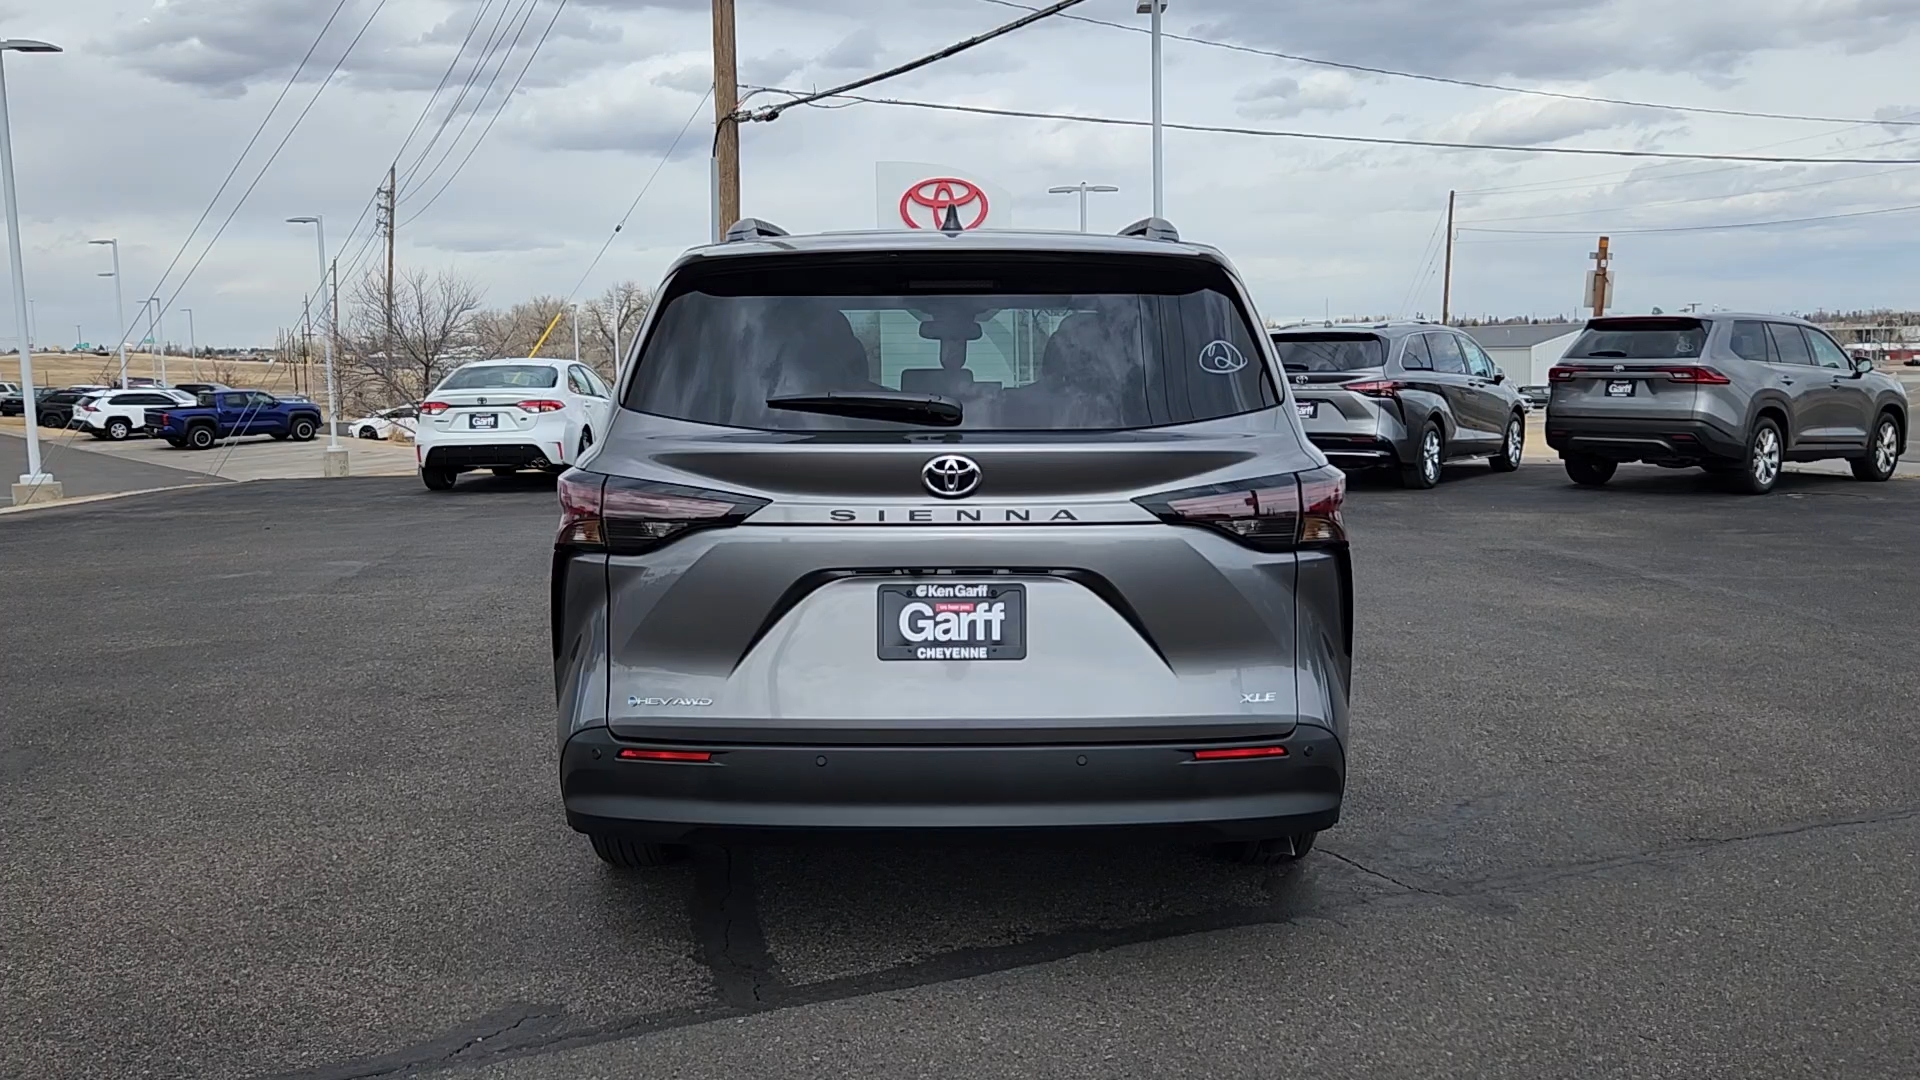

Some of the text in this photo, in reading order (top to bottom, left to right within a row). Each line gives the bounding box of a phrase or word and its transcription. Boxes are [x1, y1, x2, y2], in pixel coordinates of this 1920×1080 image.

[830, 509, 1078, 522] SIENNA
[928, 585, 988, 597] Ken Garff
[899, 602, 1005, 642] Garff
[917, 647, 988, 659] CHEYENNE
[1240, 692, 1277, 704] XLE
